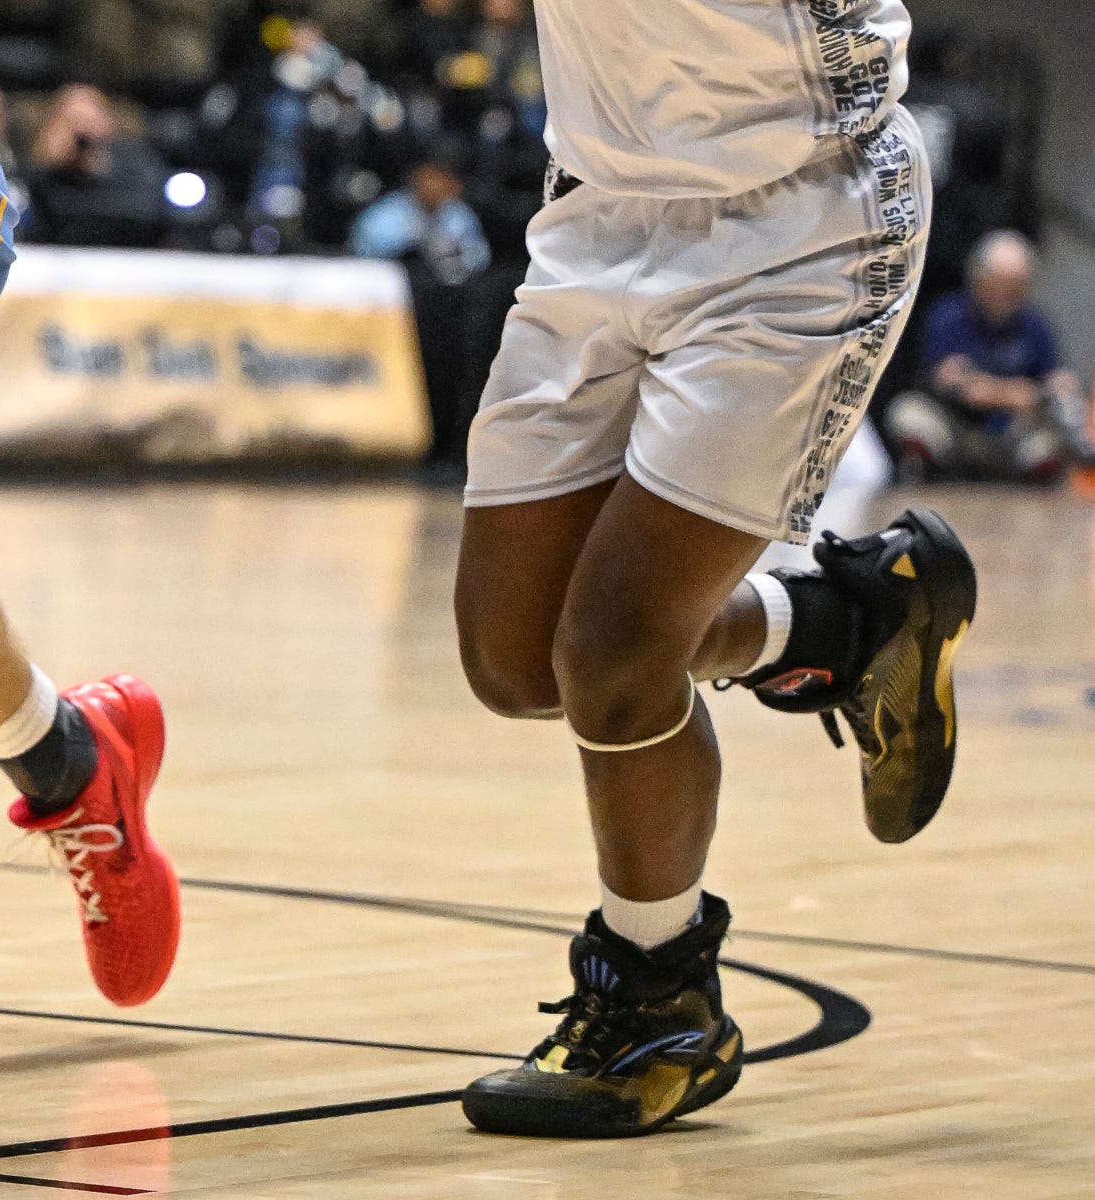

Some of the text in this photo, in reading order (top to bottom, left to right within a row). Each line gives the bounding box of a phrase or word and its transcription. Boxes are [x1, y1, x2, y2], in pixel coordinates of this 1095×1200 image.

[828, 75, 855, 112] ME
[848, 62, 876, 114] GOT
[877, 168, 899, 204] WON
[863, 255, 889, 309] HONO
